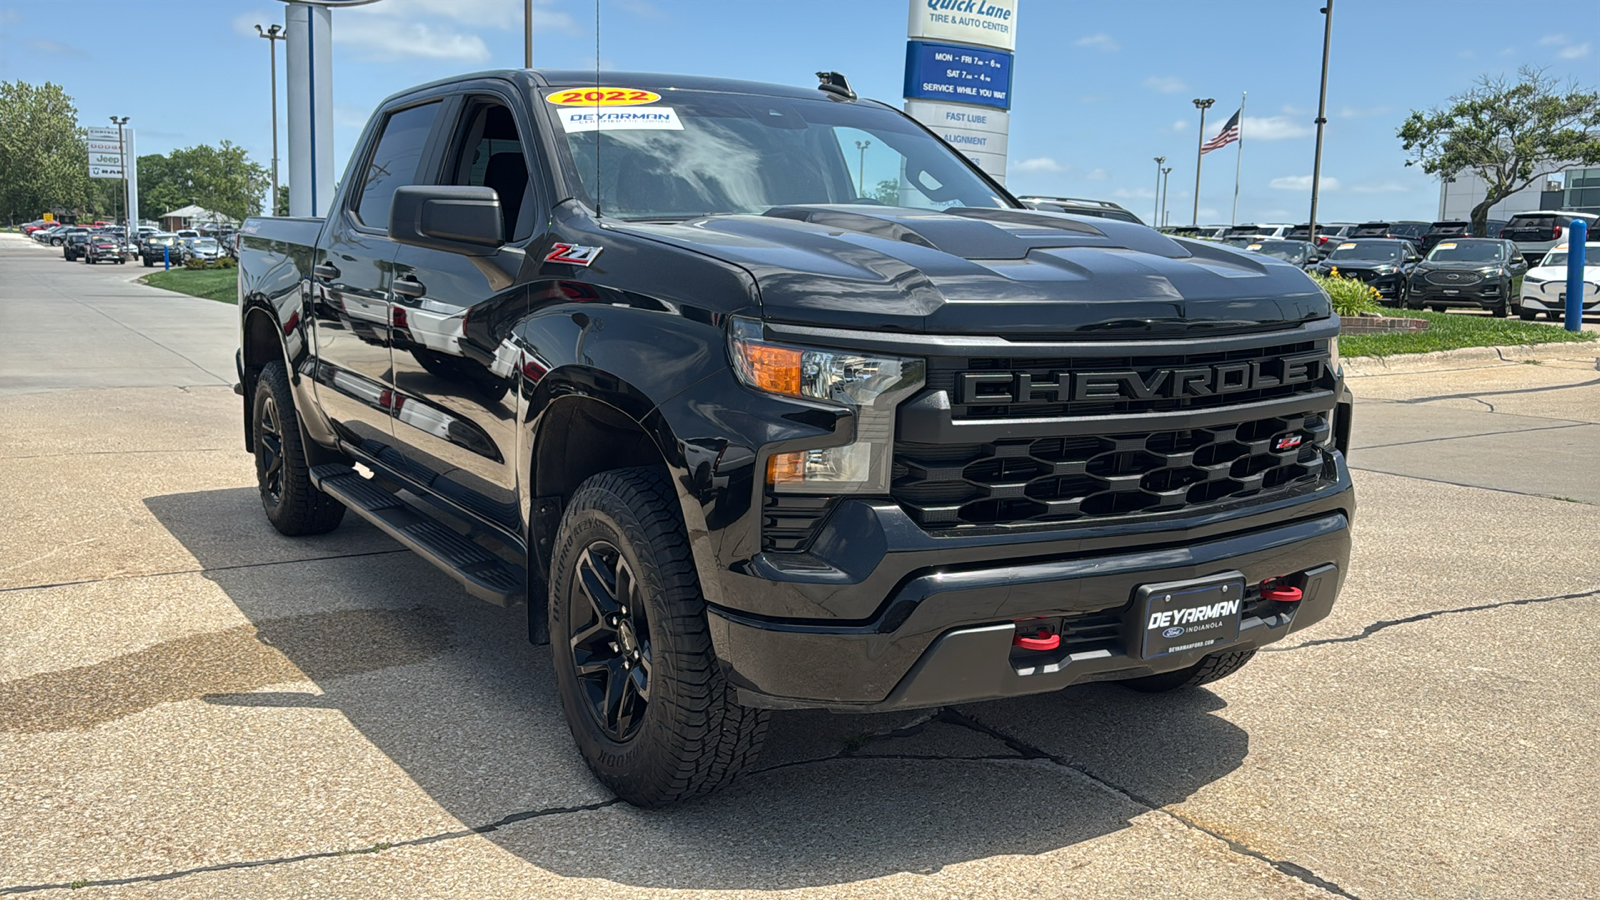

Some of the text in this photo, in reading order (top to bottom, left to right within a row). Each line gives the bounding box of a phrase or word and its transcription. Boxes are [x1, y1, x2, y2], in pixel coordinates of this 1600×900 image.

[977, 0, 1011, 20] Lane
[930, 13, 1009, 33] TIRE & AUTO CENTER
[935, 53, 953, 62] MON
[961, 55, 972, 64] FRI
[946, 69, 960, 78] SAT
[562, 91, 649, 103] 2022
[923, 83, 1006, 99] SERVICE WHILE YOU WAIT
[570, 113, 670, 121] DEYARMAN
[946, 112, 987, 124] FAST LUBE
[944, 134, 987, 146] ALIGNMENT
[96, 154, 119, 164] Jeep
[544, 242, 603, 267] Z71
[960, 352, 1330, 404] CHEVROLET
[1147, 599, 1240, 630] DEYARMAN
[1186, 621, 1223, 633] INDIANOLA
[1168, 639, 1215, 653] DEYARMANFORD.COM
